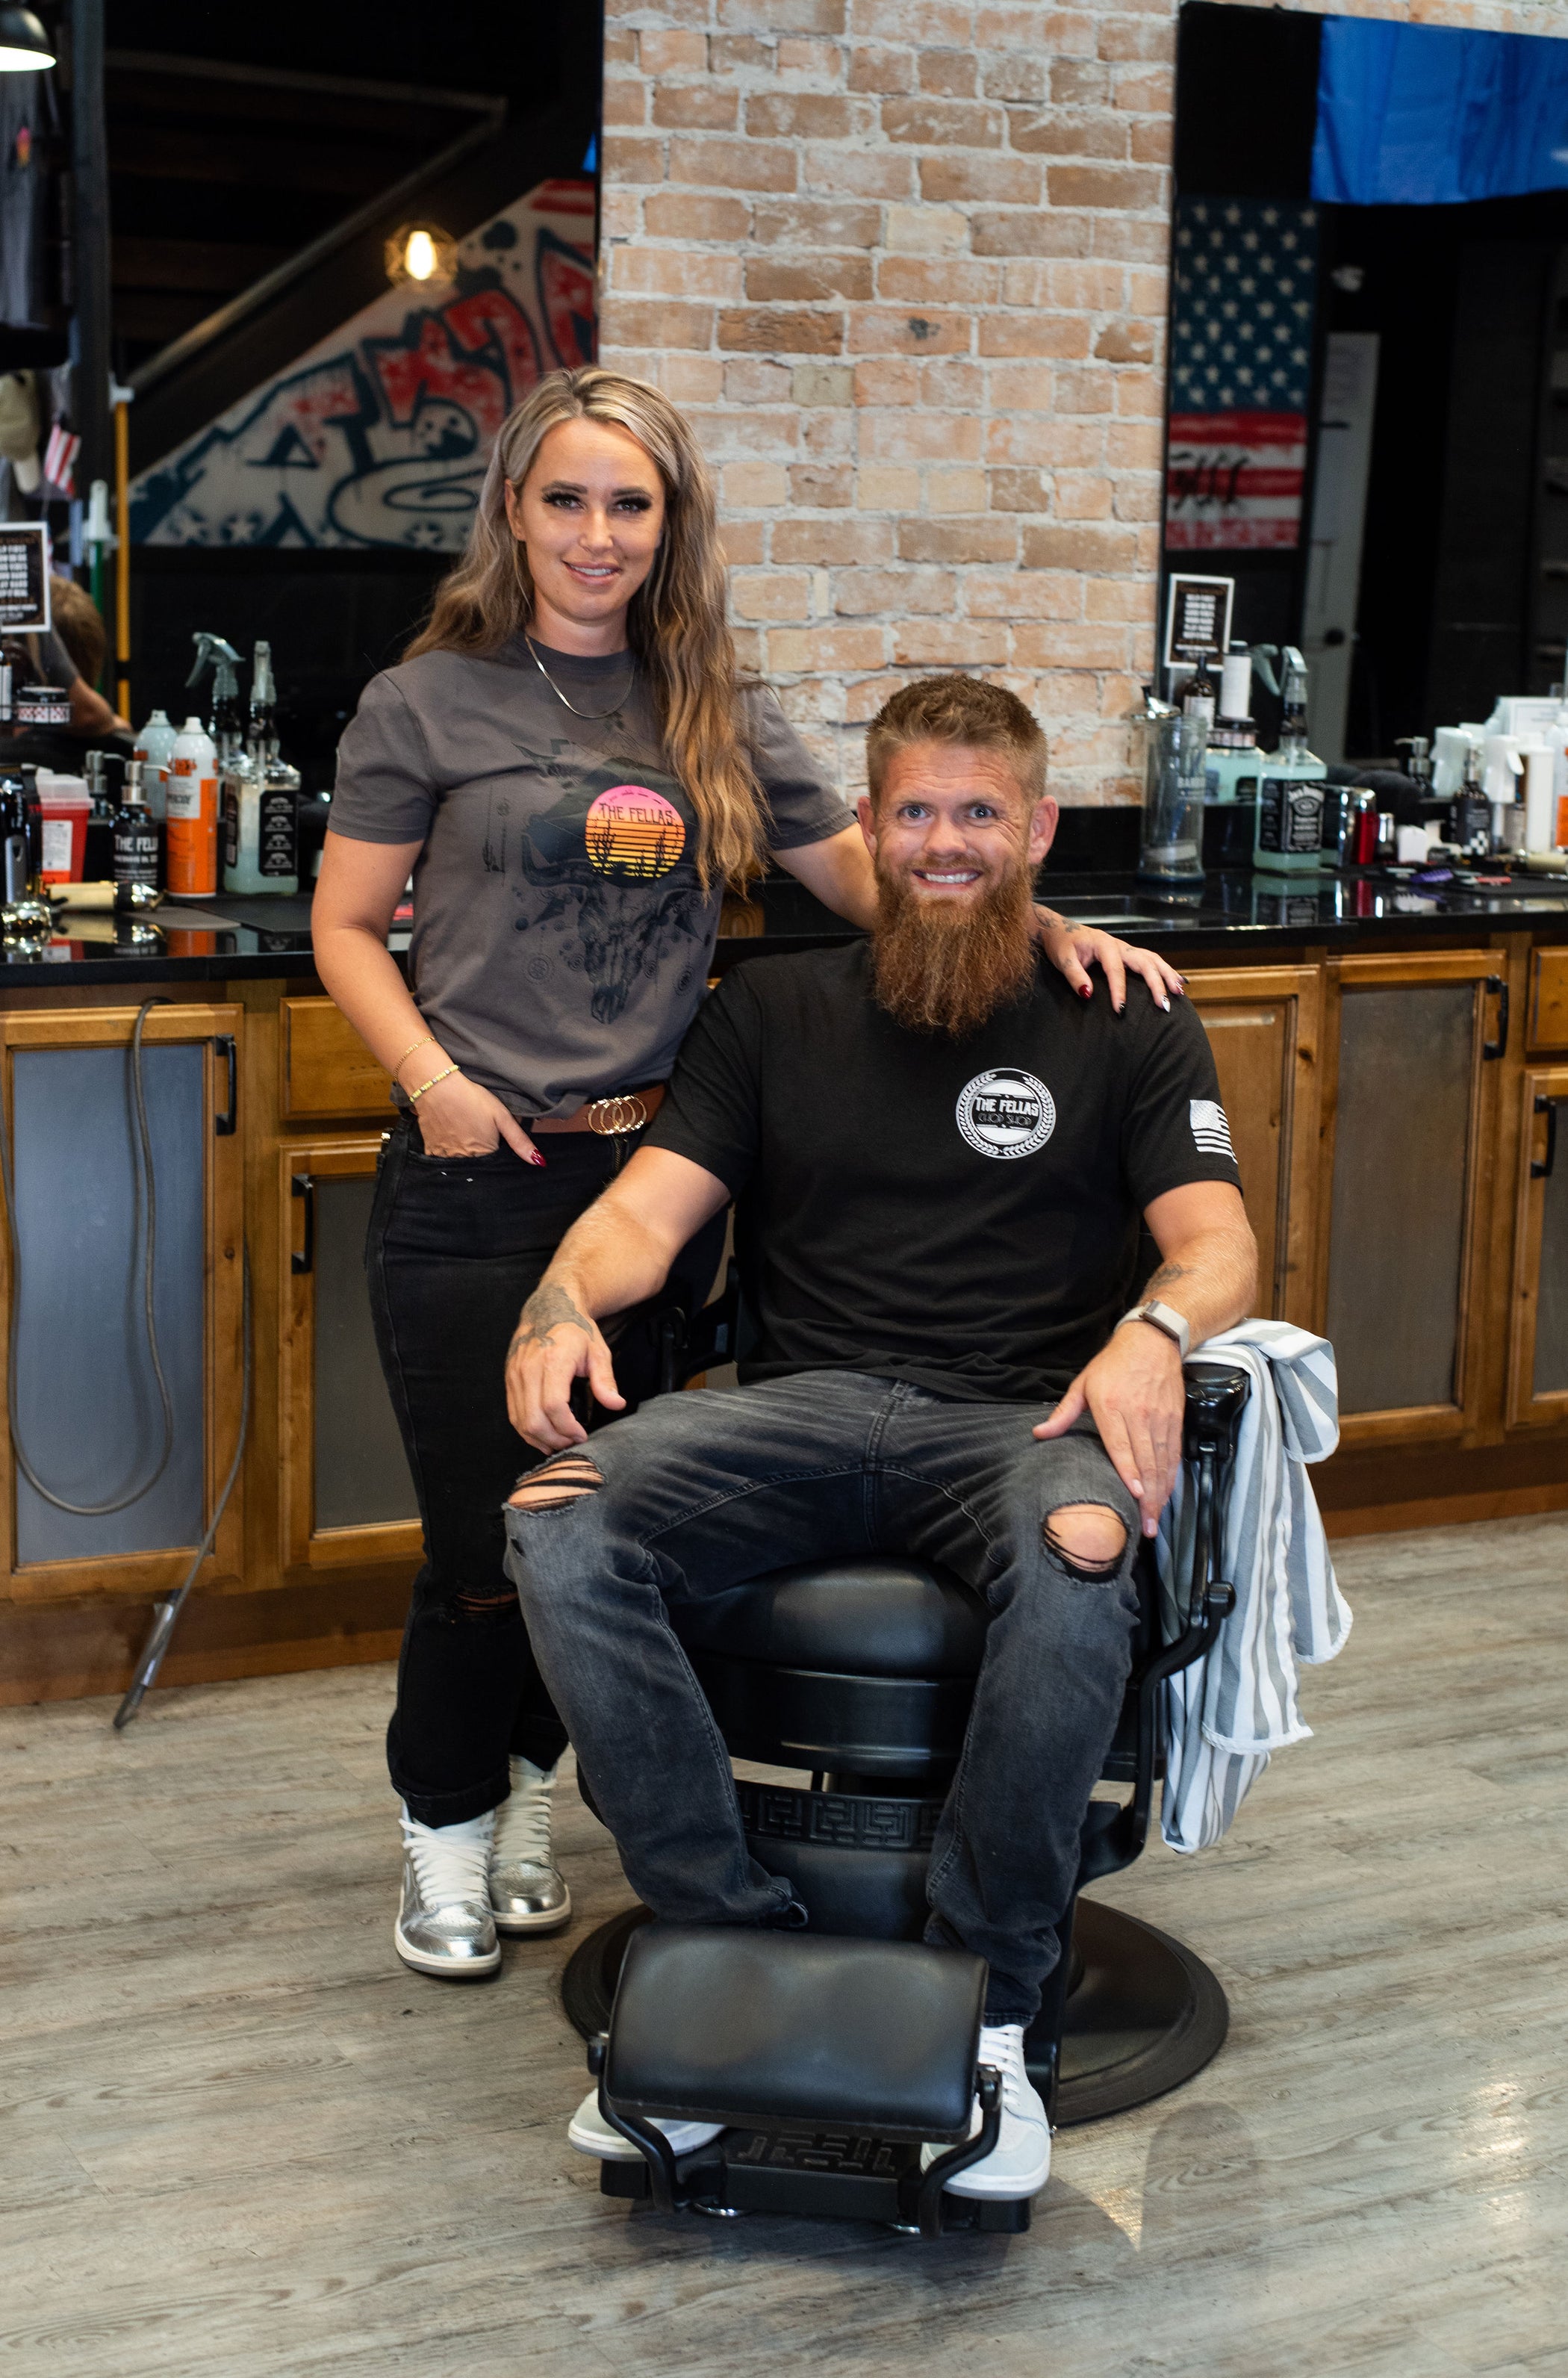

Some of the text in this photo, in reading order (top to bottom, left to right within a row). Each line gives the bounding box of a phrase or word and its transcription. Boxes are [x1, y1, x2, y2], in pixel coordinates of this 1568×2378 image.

[600, 803, 675, 825] THE FELLAS
[114, 834, 134, 851] THE
[975, 1096, 1039, 1117] THE FELLAS
[978, 1113, 1032, 1126] CHOP SHOP
